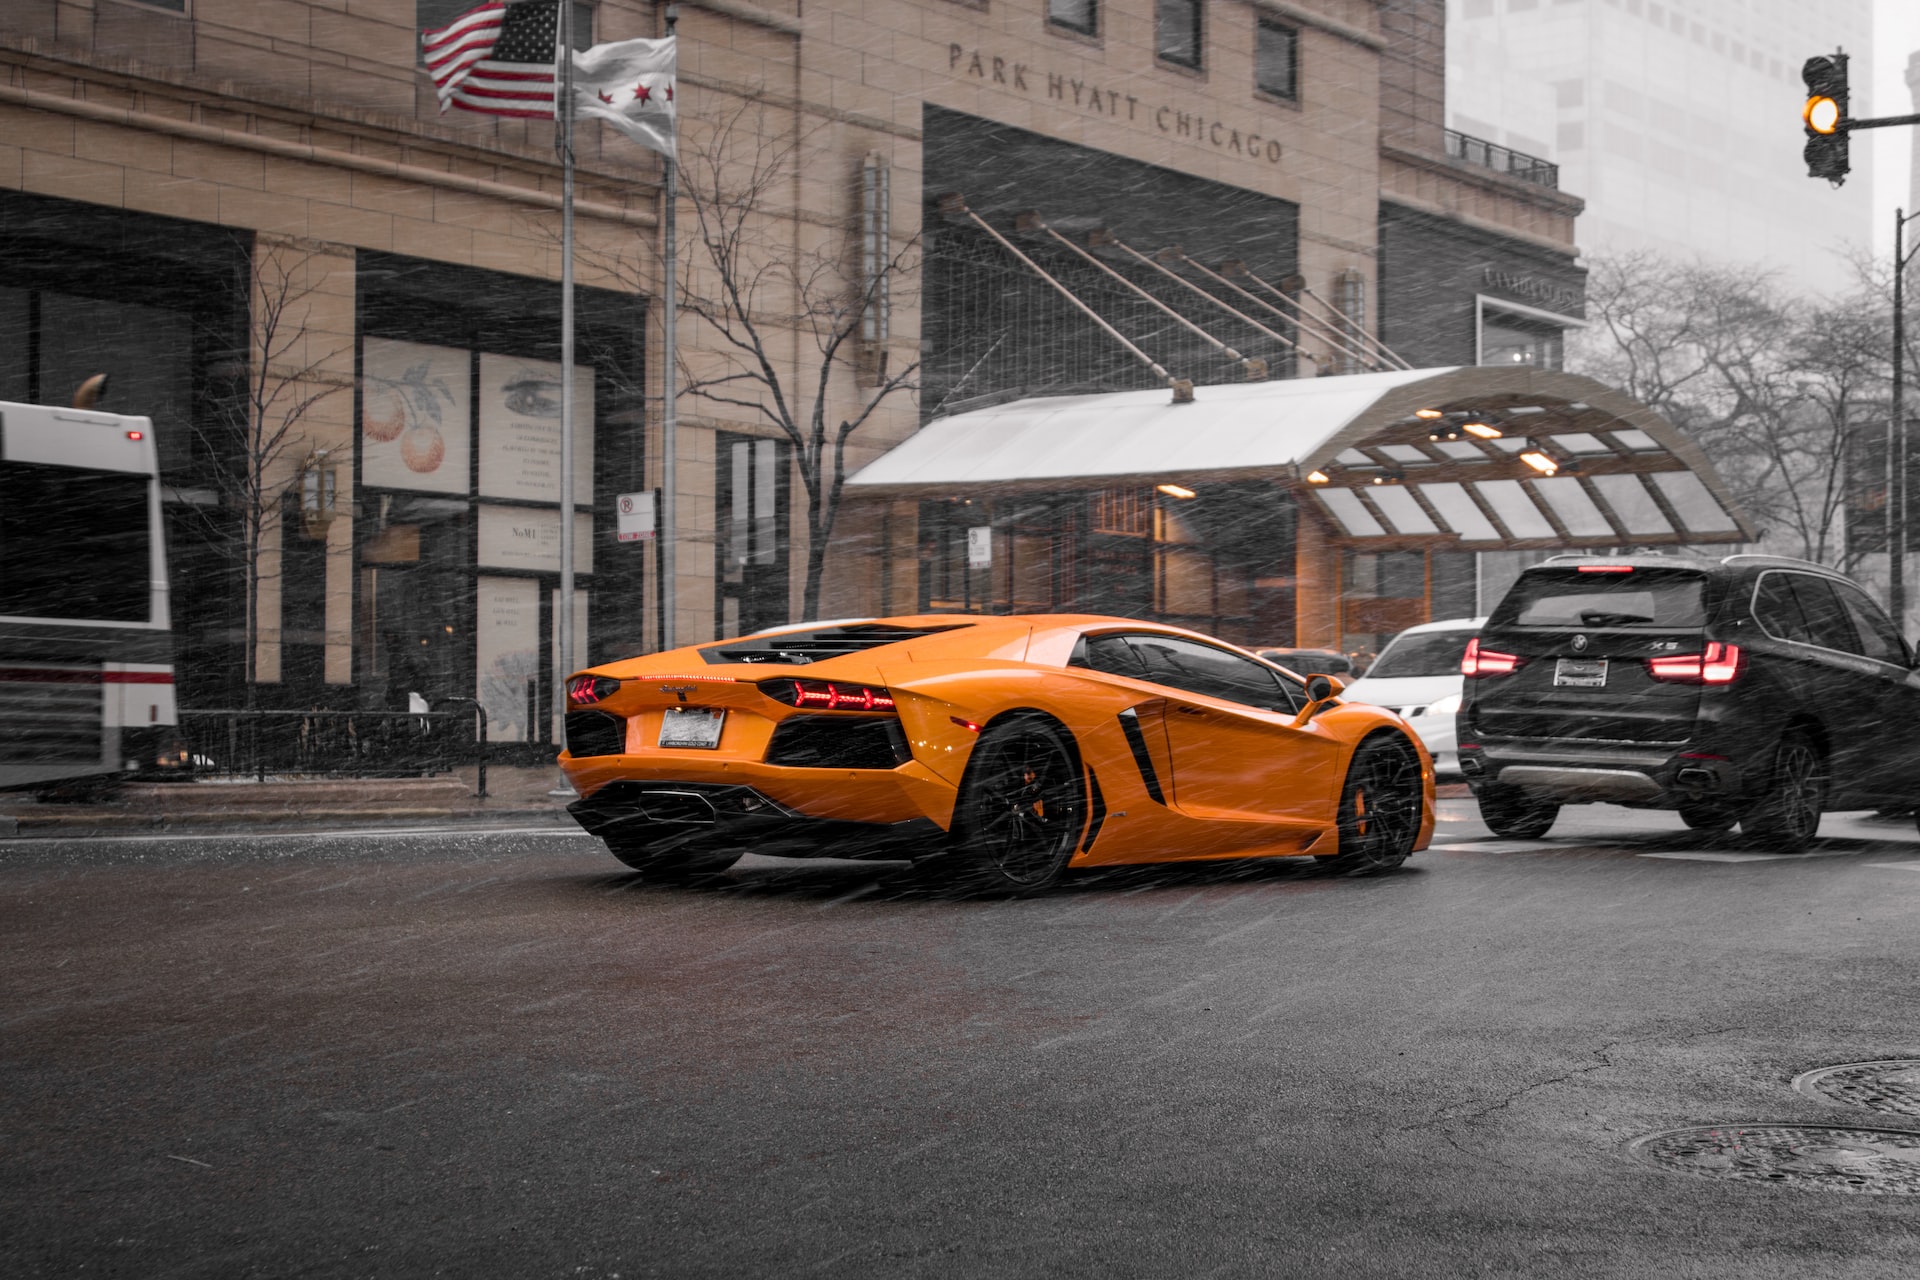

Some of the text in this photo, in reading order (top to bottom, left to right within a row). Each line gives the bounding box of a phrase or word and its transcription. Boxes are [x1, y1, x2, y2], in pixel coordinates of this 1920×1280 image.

[949, 42, 1283, 164] PARK HYATT CHICAGO
[1650, 641, 1679, 650] X5
